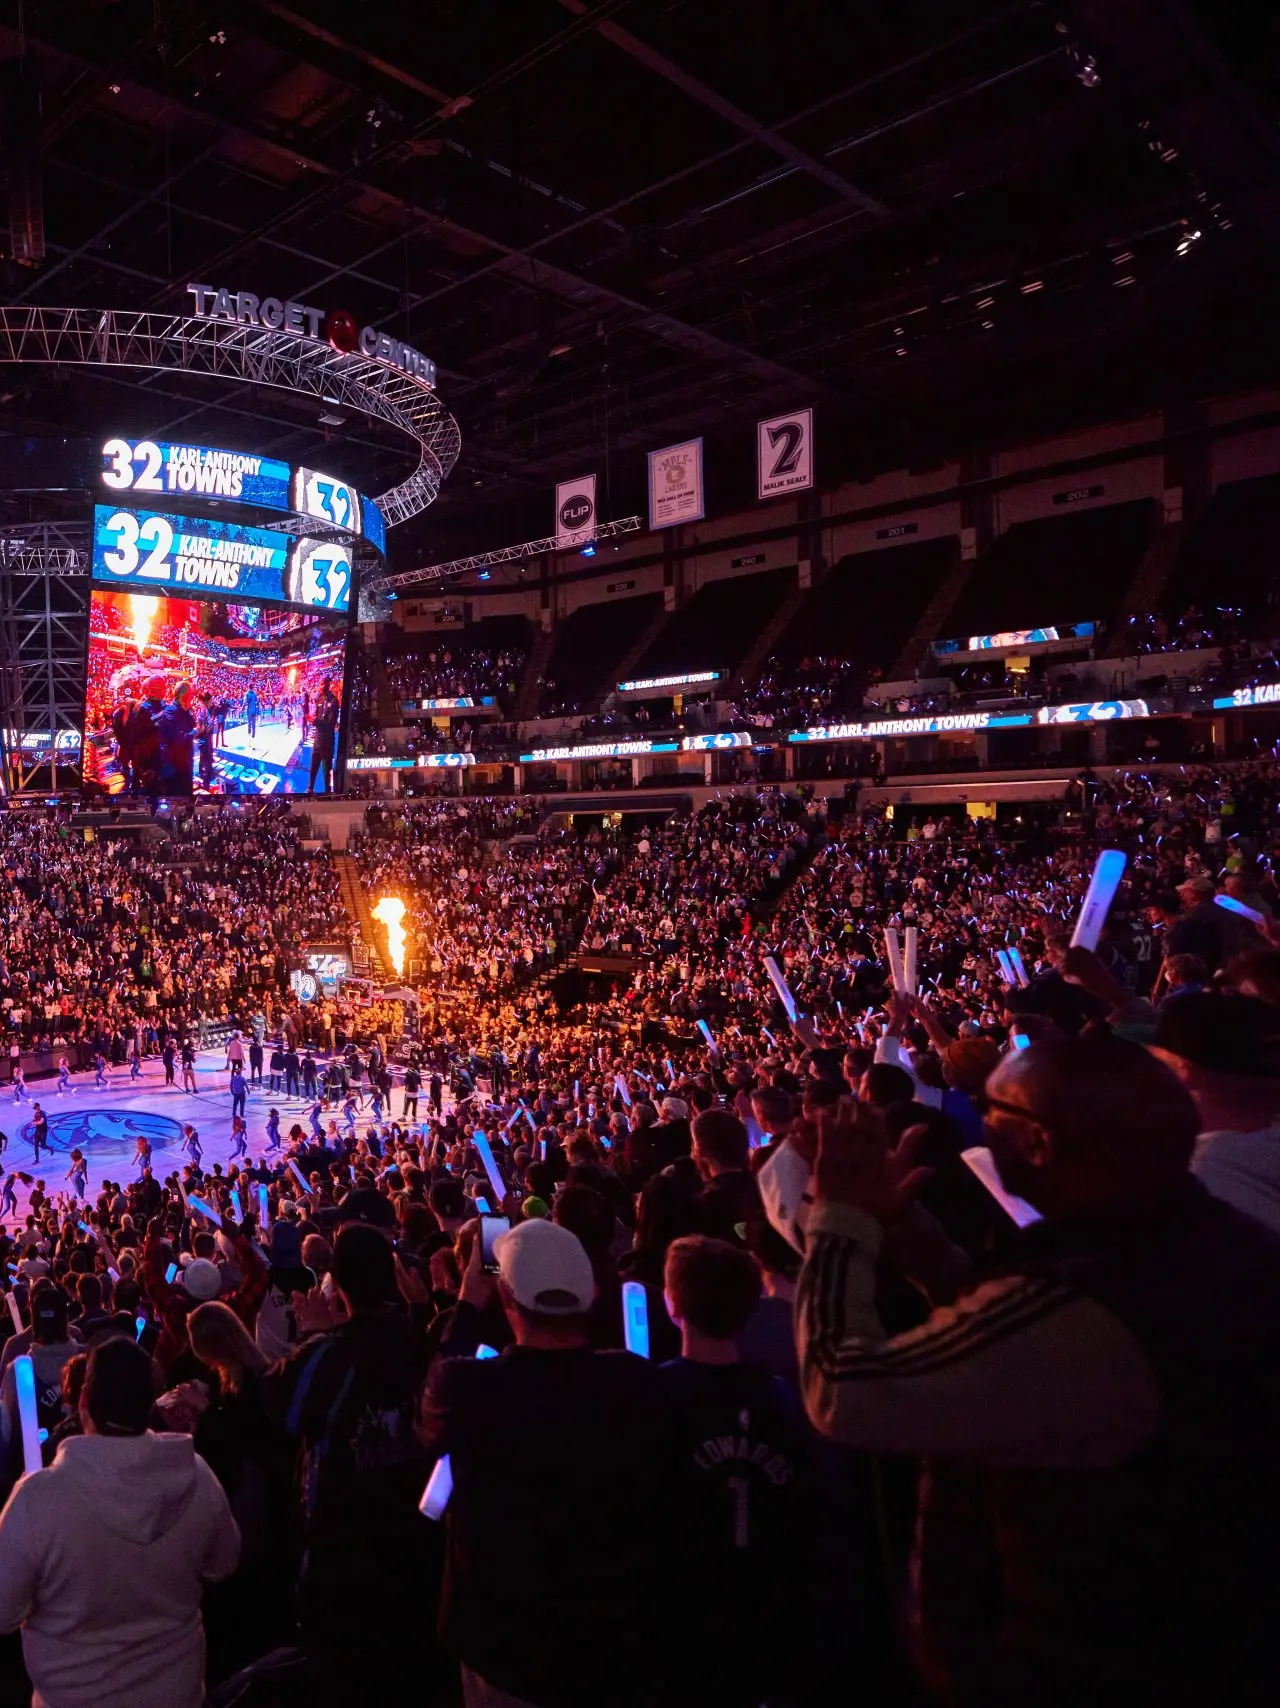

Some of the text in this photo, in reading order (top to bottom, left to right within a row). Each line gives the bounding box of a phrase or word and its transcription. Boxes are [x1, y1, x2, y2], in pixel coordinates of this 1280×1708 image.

[187, 283, 437, 389] TARGET CENTER
[102, 439, 164, 491] 32
[168, 446, 262, 476] KARL-ANTHONY
[767, 422, 804, 479] 2
[167, 463, 242, 498] TOWNS
[763, 475, 807, 491] MALIK SEALY
[317, 481, 352, 528] 32
[563, 505, 589, 520] FLIP
[104, 512, 174, 580] 32
[181, 534, 276, 568] KARL-ANTHONY
[176, 557, 241, 588] TOWNS
[312, 558, 351, 608] 32
[688, 672, 713, 682] TOWNS
[1233, 689, 1252, 706] 32
[808, 713, 989, 739] 32 KARL-ANTHONY TOWNS
[362, 758, 392, 768] TOWNS
[532, 741, 652, 760] 32 KARL-ANTHONY TOWNS
[693, 1434, 795, 1486] EDWARDS
[727, 1476, 751, 1548] 1
